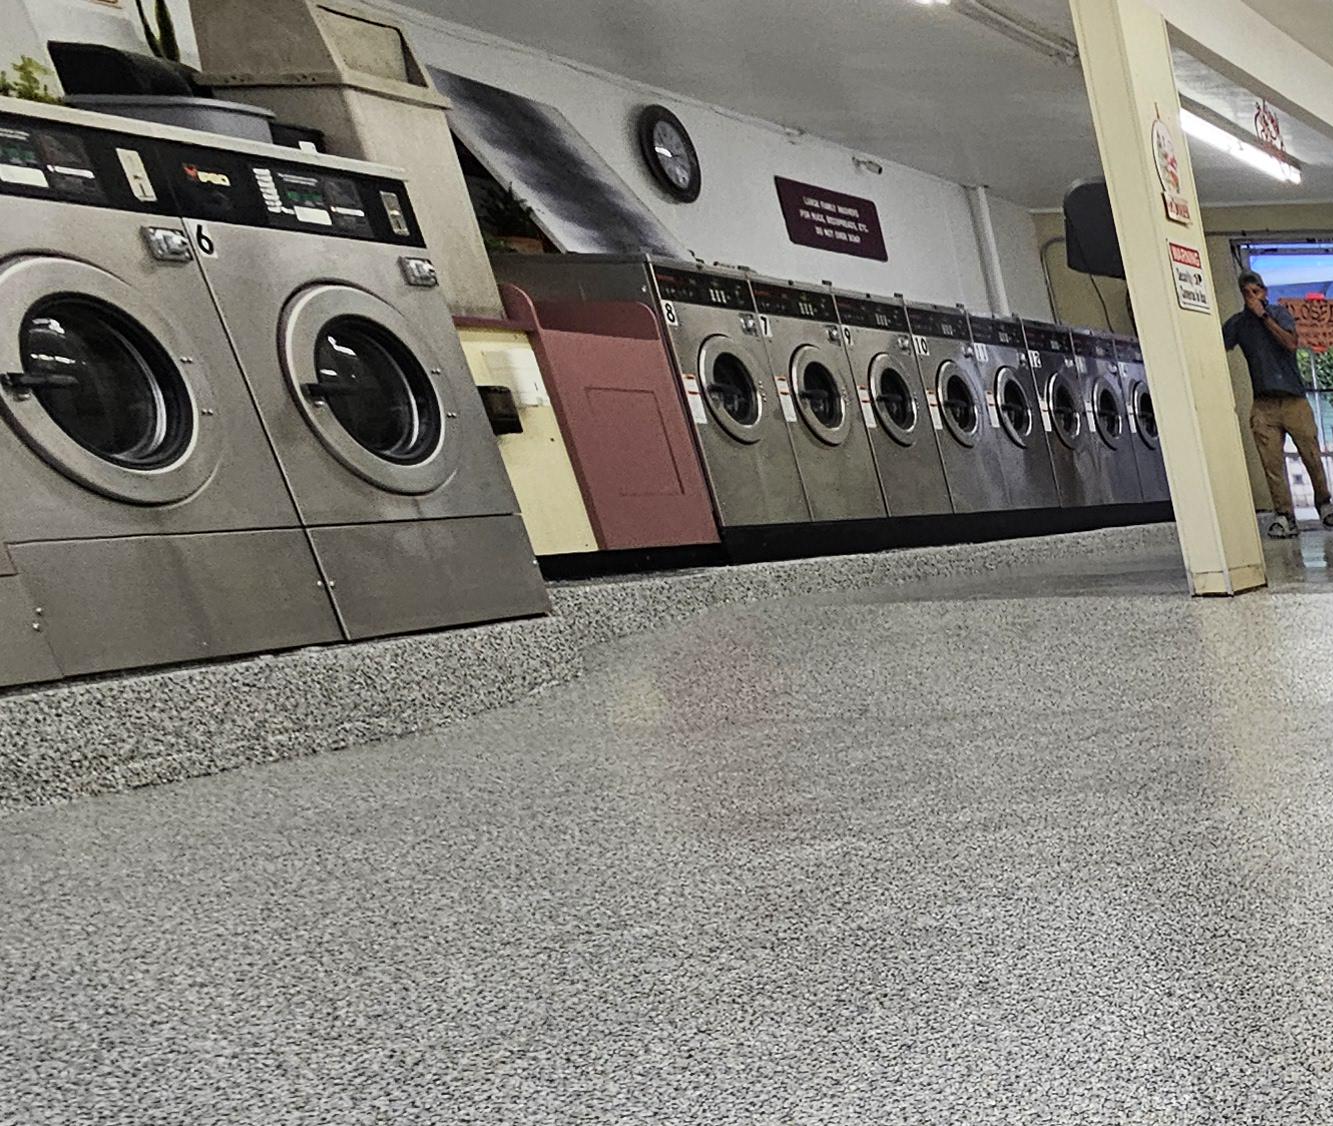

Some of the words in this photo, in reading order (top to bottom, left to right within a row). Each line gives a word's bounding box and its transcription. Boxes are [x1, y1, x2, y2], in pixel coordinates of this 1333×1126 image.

[196, 224, 214, 255] 6
[664, 303, 675, 323] 8
[759, 317, 769, 336] 7
[843, 328, 852, 344] 9
[914, 337, 928, 354] 10
